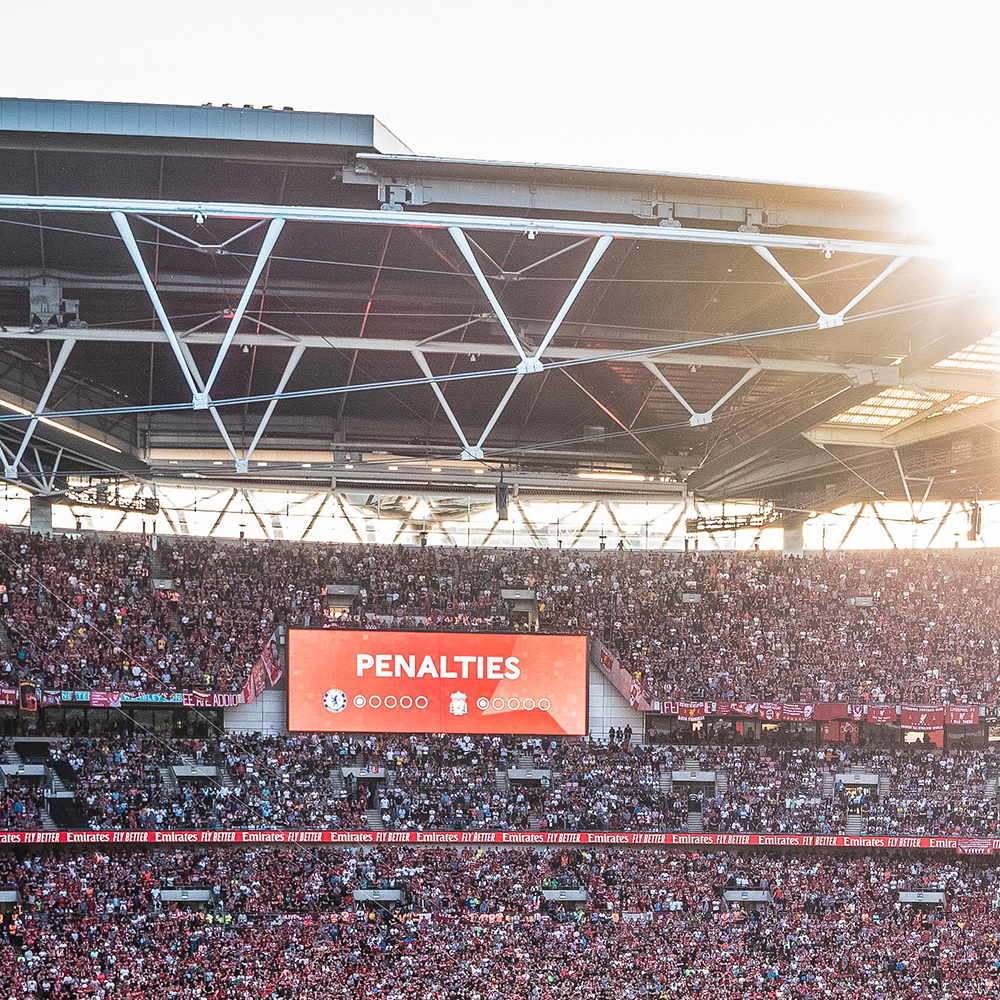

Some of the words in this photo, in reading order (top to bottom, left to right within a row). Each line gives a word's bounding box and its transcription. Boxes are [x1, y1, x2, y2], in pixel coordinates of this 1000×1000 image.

[356, 654, 520, 680] PENALTIES
[213, 694, 238, 706] ADDIO
[37, 833, 60, 842] BETTER
[66, 833, 110, 842] Emirates
[125, 832, 148, 842] BETTER
[156, 832, 197, 842] Emirates
[213, 832, 236, 842] BETTER
[242, 832, 284, 842] Emirates
[300, 832, 322, 842] BETTER
[331, 832, 372, 842] Emirates
[388, 832, 410, 842] BETTER
[417, 833, 458, 842] Emirates
[474, 833, 495, 842] BETTER
[503, 833, 543, 842] Emirates
[559, 834, 580, 843] BETTER
[588, 834, 628, 843] Emirates
[644, 834, 665, 844] BETTER
[672, 835, 713, 844] Emirates
[728, 835, 749, 845] BETTER
[759, 836, 799, 845] Emirates
[816, 836, 837, 846] BETTER
[844, 837, 884, 847] Emirates
[888, 838, 898, 847] FLY
[899, 838, 920, 847] BETTER
